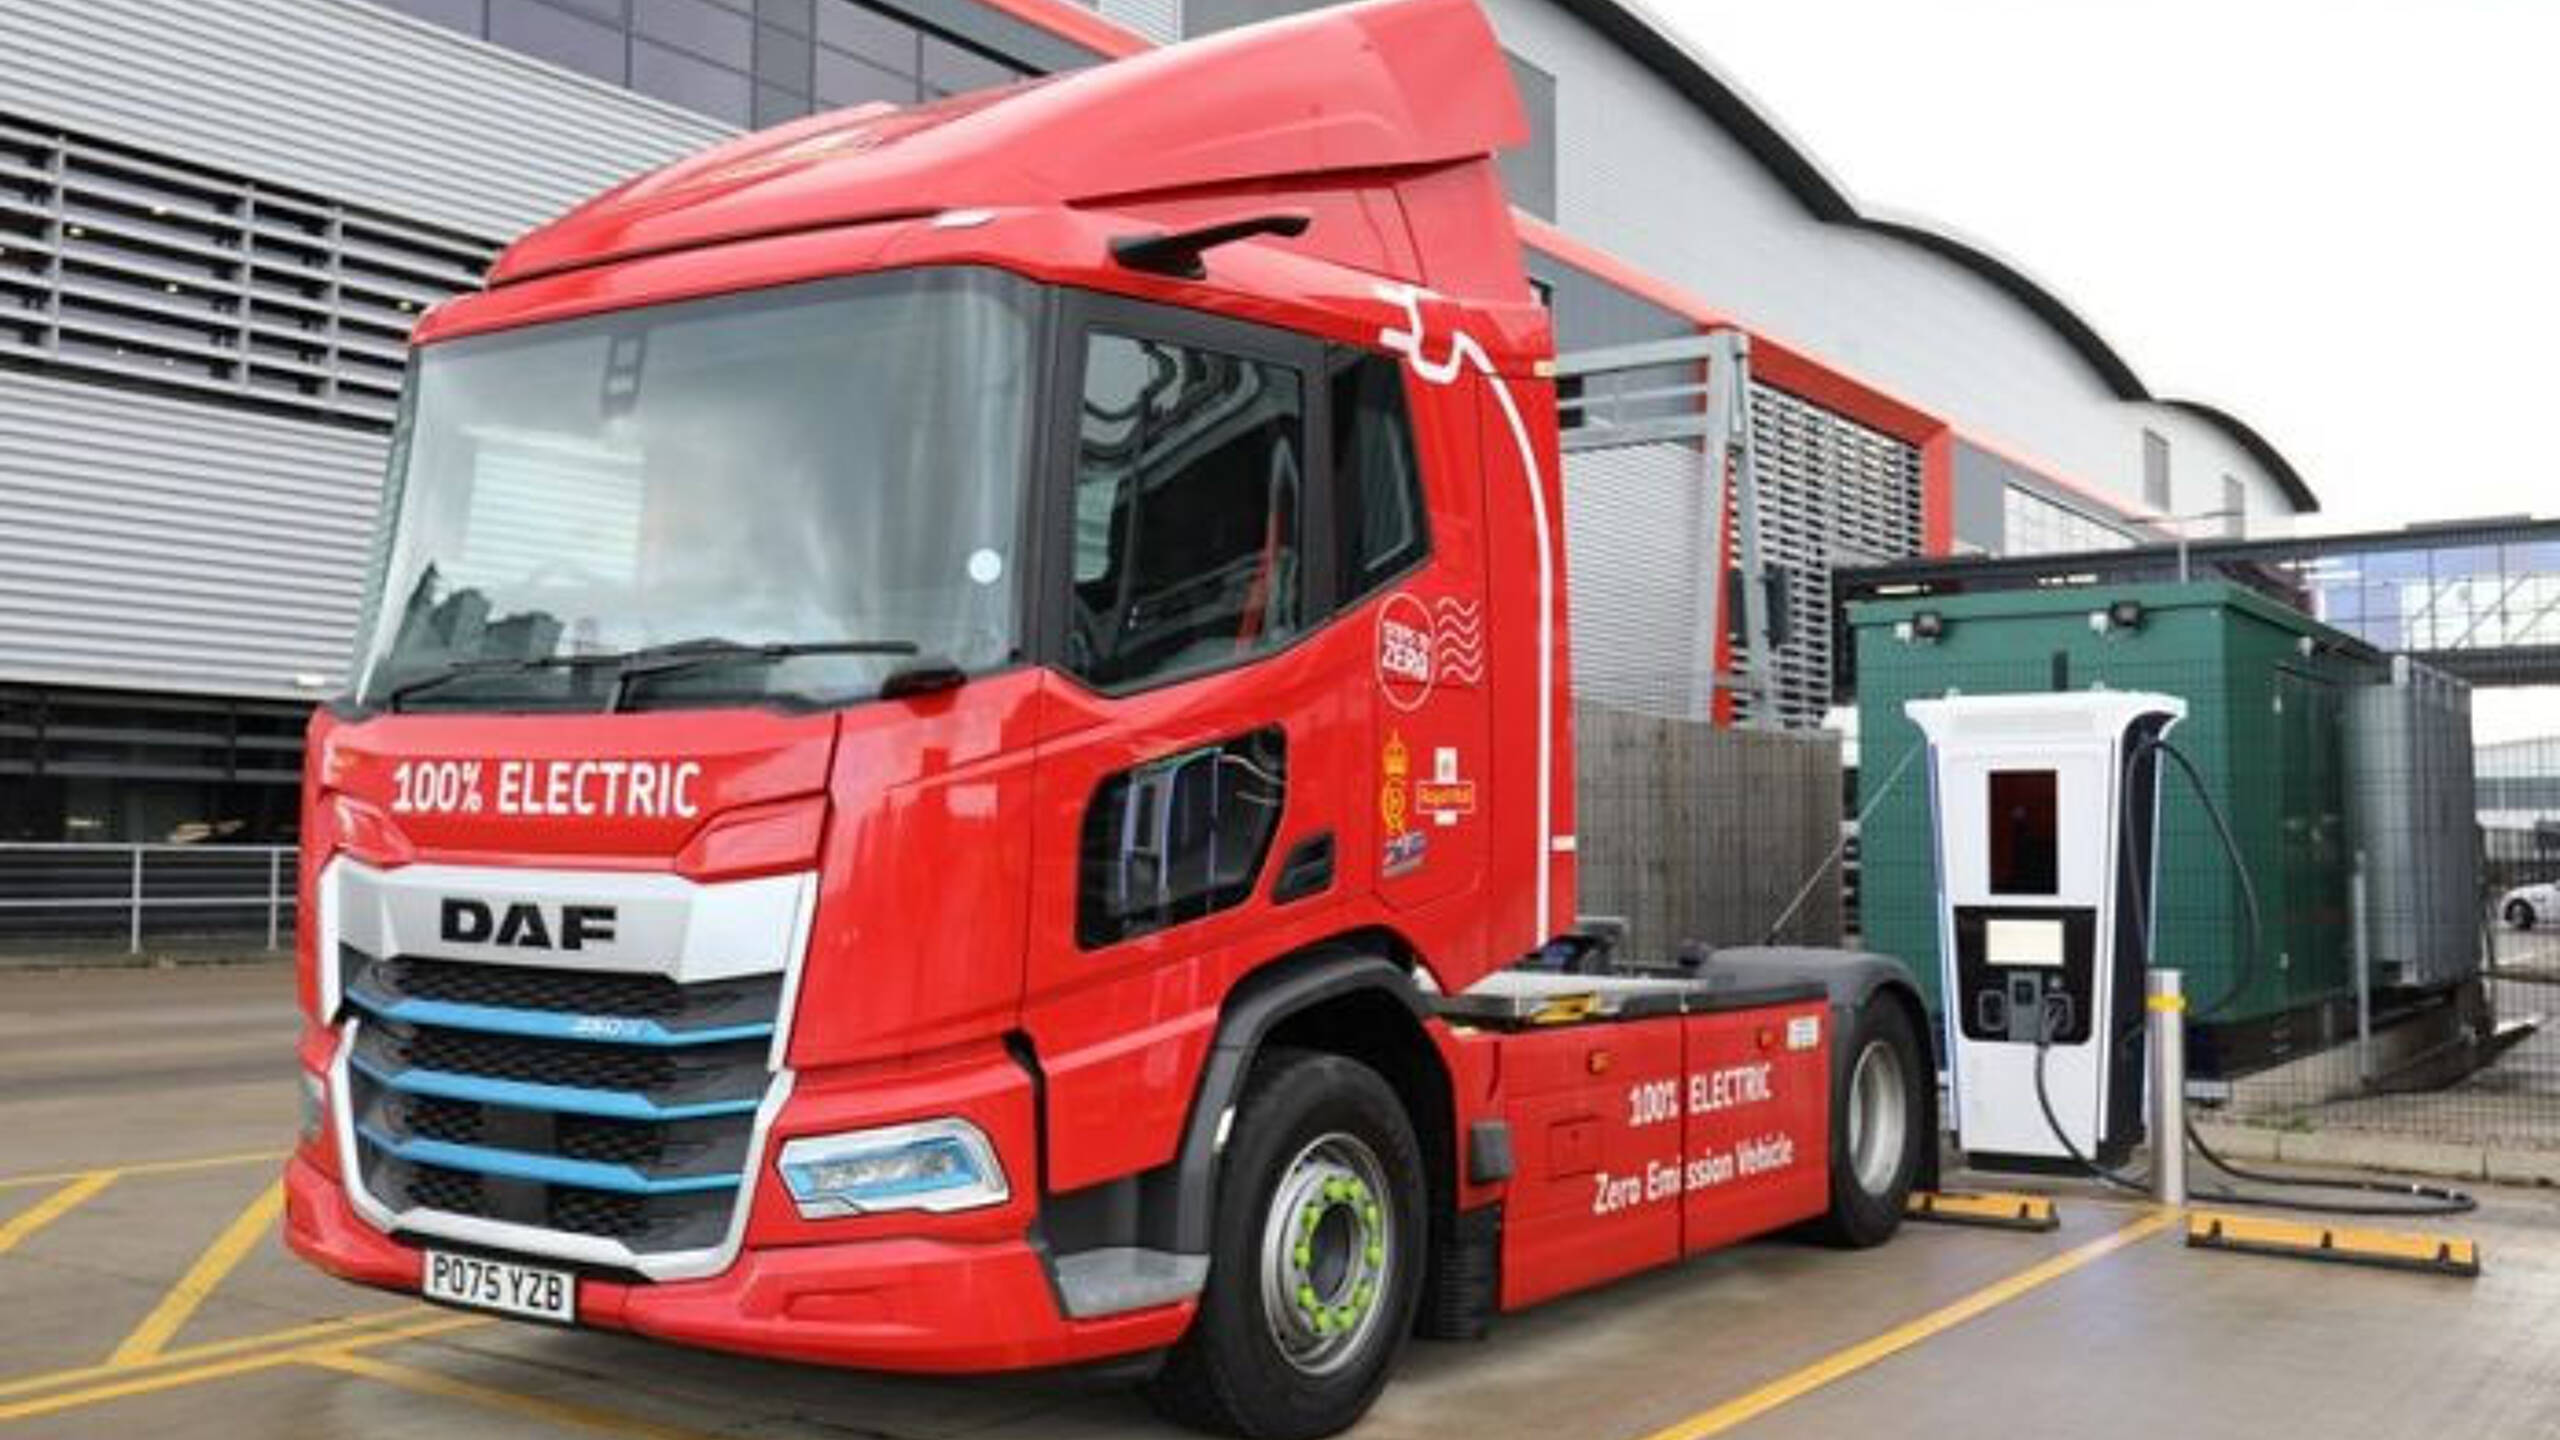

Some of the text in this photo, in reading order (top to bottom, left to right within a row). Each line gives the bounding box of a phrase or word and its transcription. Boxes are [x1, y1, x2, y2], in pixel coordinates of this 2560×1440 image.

[392, 761, 700, 817] 100% ELECTRIC
[441, 898, 616, 950] DAF
[1687, 1062, 1772, 1115] ELECTRIC
[1592, 1132, 1793, 1214] Zero Emission Vehicle
[432, 1253, 563, 1311] PO75 YZB
